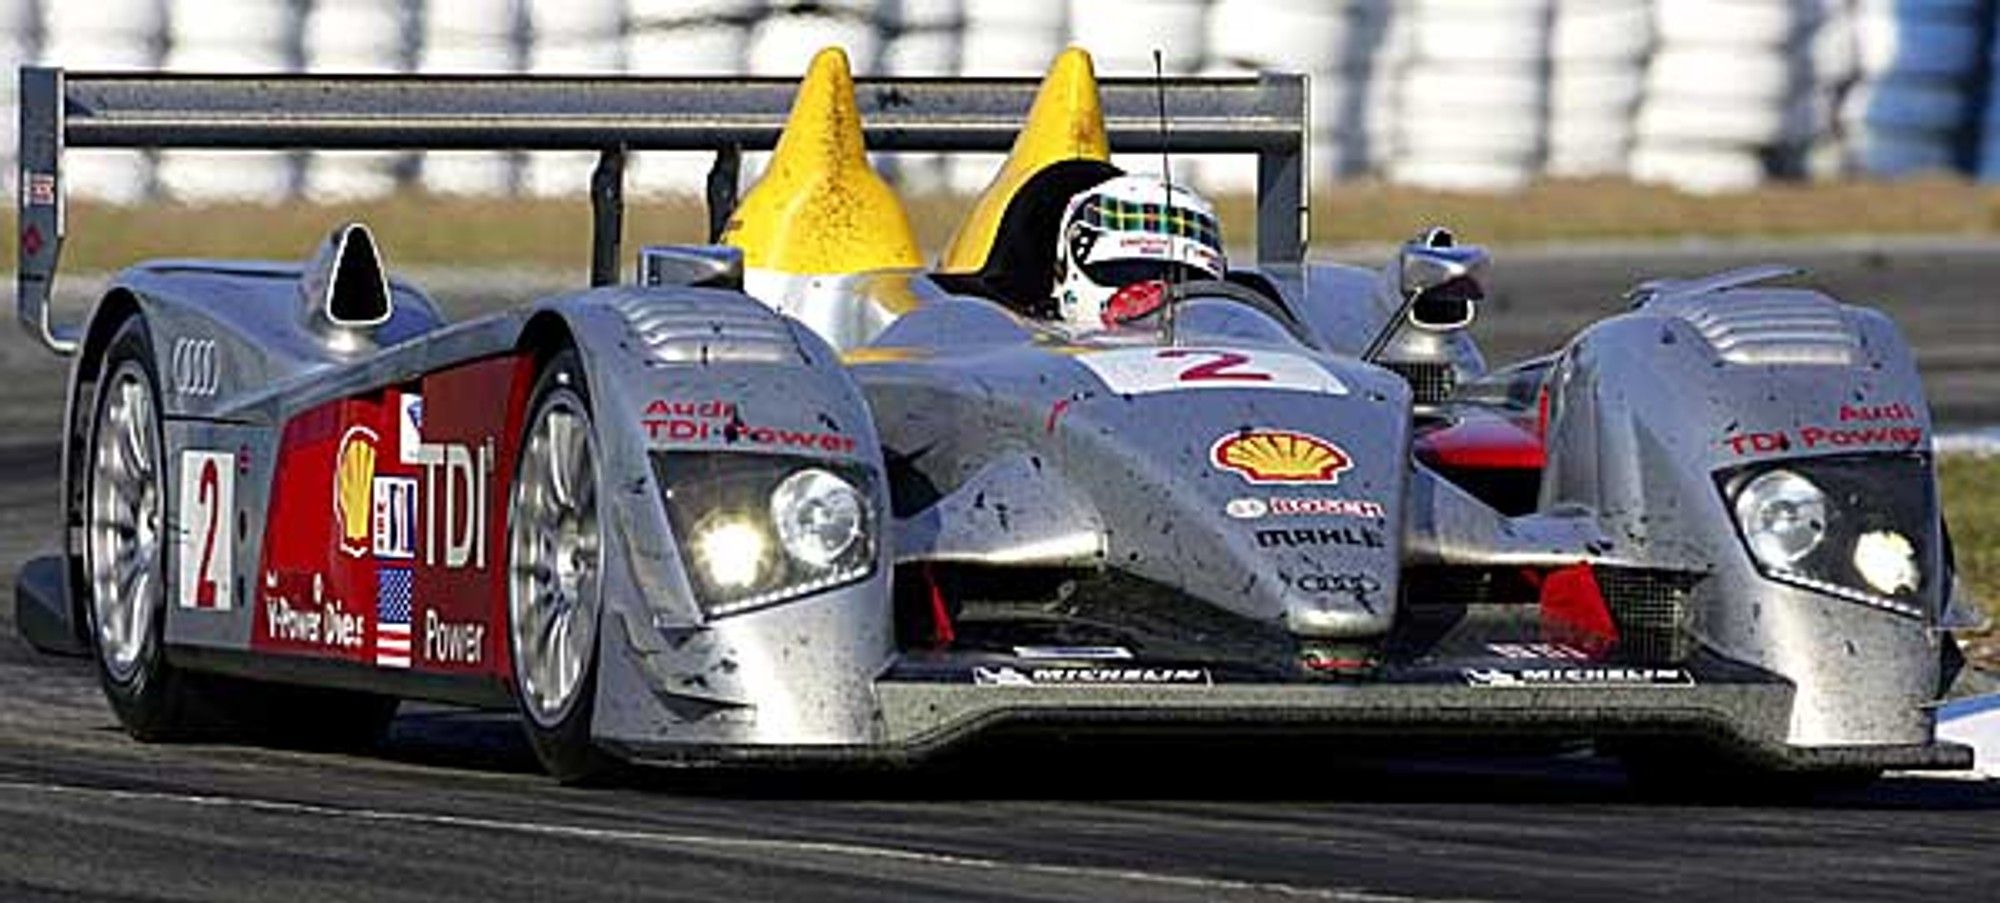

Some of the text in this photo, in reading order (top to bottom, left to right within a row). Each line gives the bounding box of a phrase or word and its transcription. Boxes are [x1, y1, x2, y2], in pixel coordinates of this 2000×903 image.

[1157, 348, 1273, 382] 2
[642, 419, 708, 440] TDI
[644, 399, 735, 418] Audi
[416, 443, 486, 568] TDI
[196, 457, 218, 608] 2
[424, 608, 487, 664] Power
